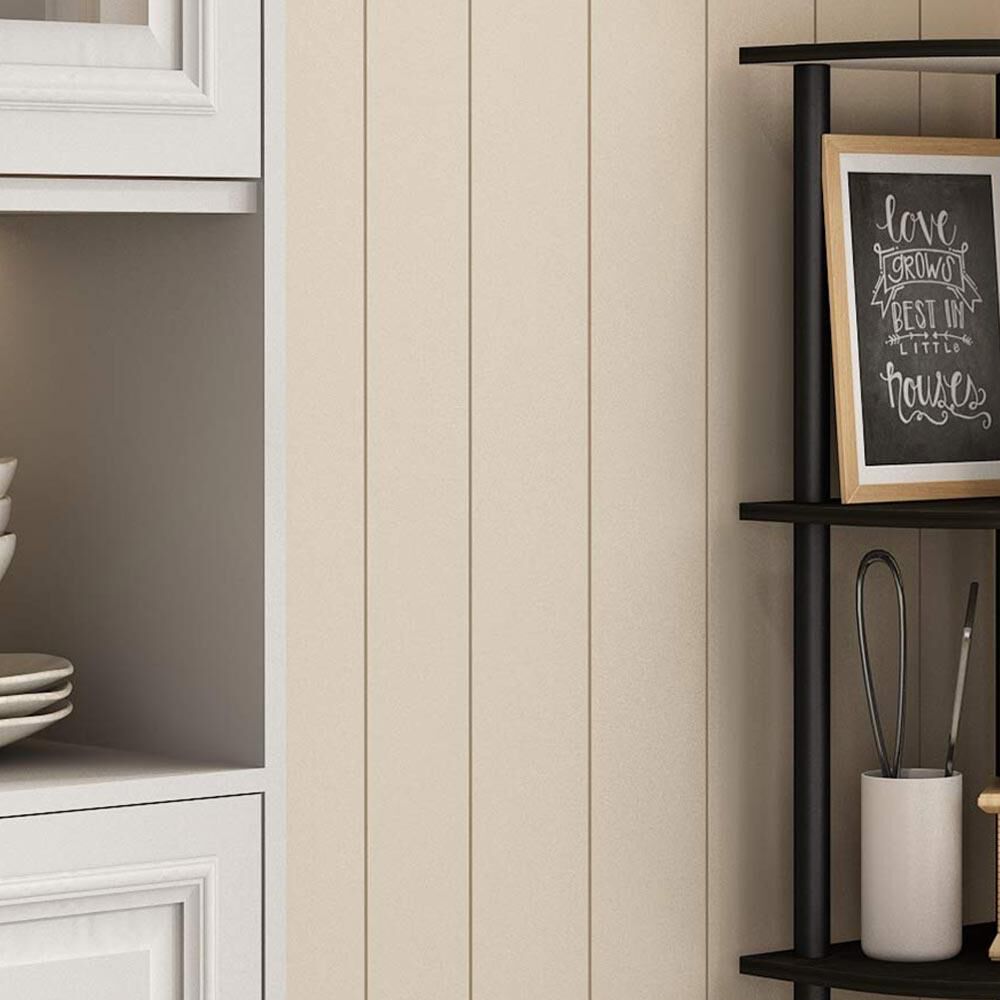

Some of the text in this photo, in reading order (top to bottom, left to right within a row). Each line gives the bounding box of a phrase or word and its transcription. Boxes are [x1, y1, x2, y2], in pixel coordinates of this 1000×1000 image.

[876, 194, 957, 246] love
[891, 298, 965, 333] BEST IN
[879, 361, 992, 430] houses
